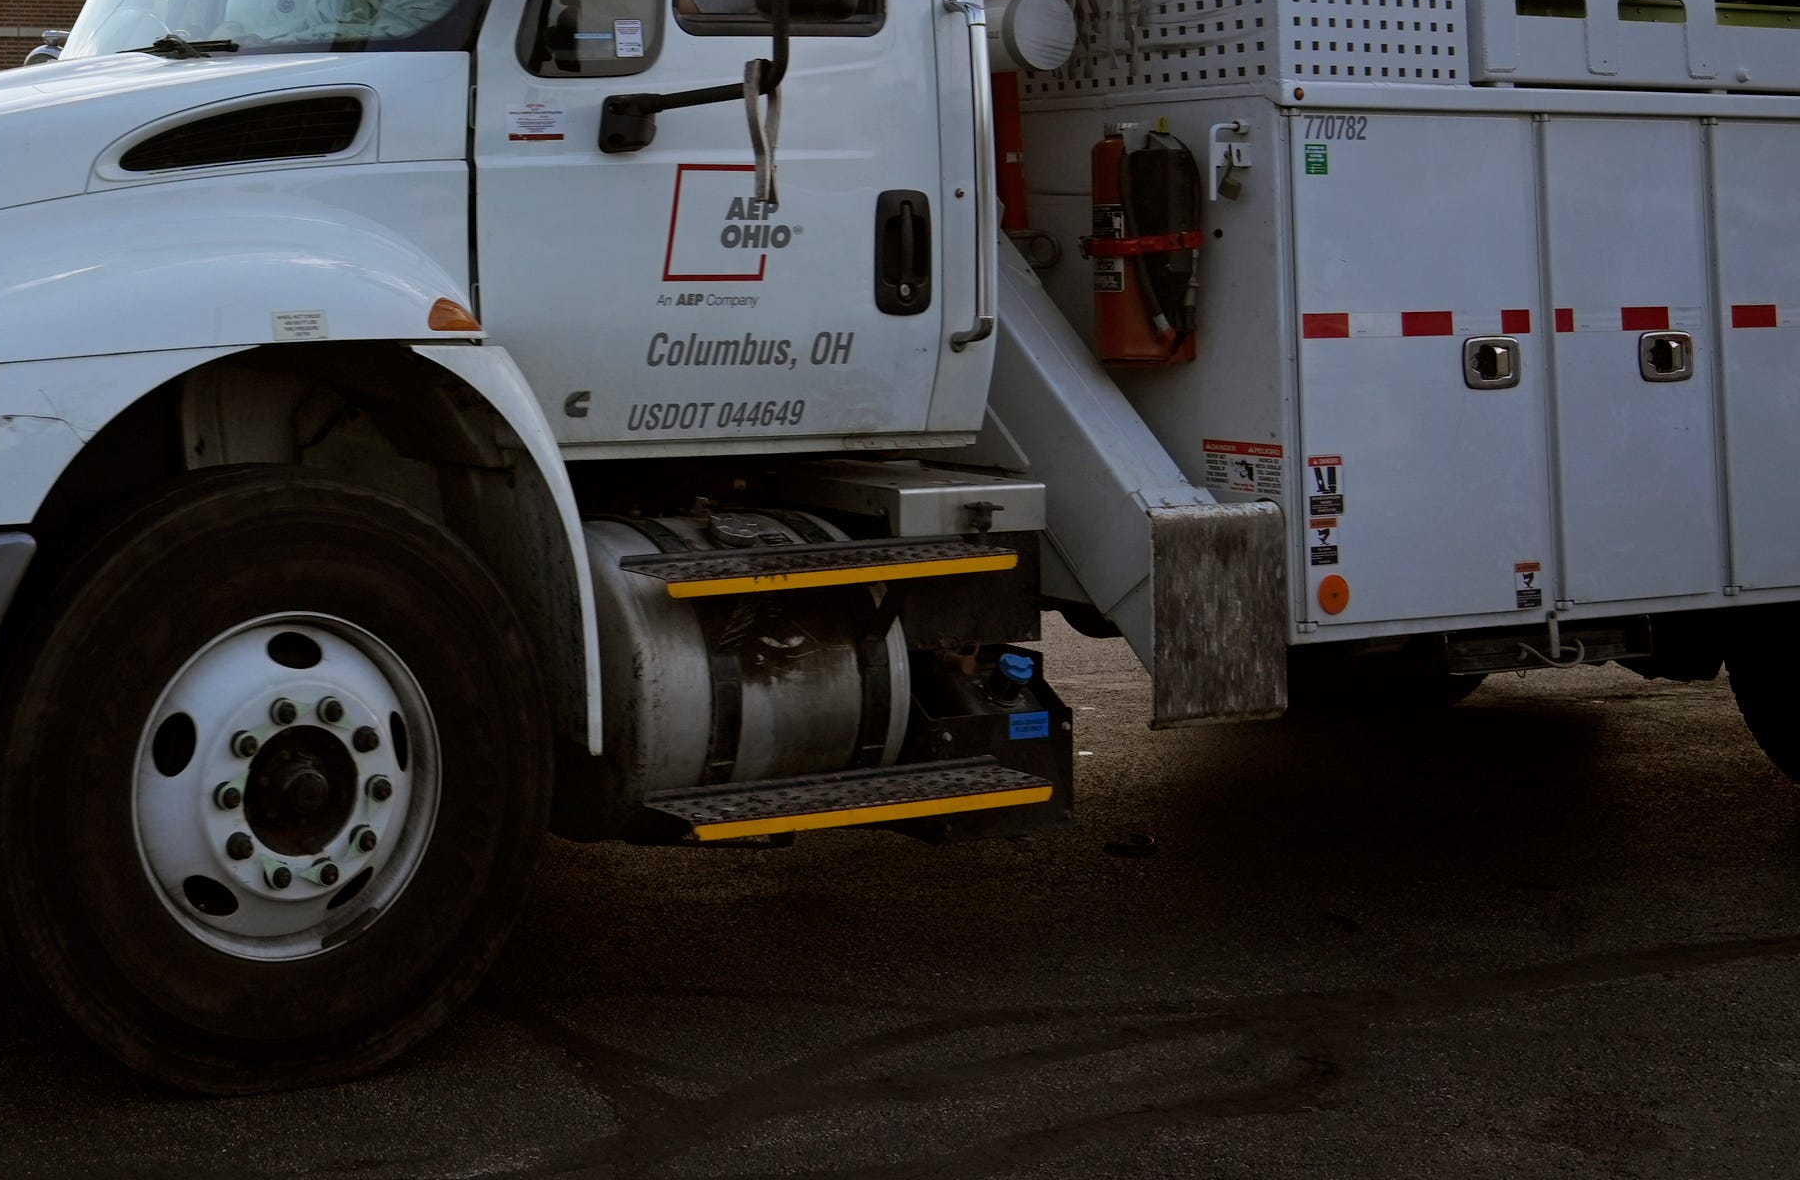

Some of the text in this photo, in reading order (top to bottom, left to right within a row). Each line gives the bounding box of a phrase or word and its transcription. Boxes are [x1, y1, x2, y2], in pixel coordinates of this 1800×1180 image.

[1304, 115, 1368, 140] 770782
[725, 196, 780, 220] AEP
[720, 224, 791, 249] OHIO
[656, 293, 760, 308] An AEP Company
[647, 331, 854, 370] Columbus, OH
[627, 399, 805, 431] USDOT 044649
